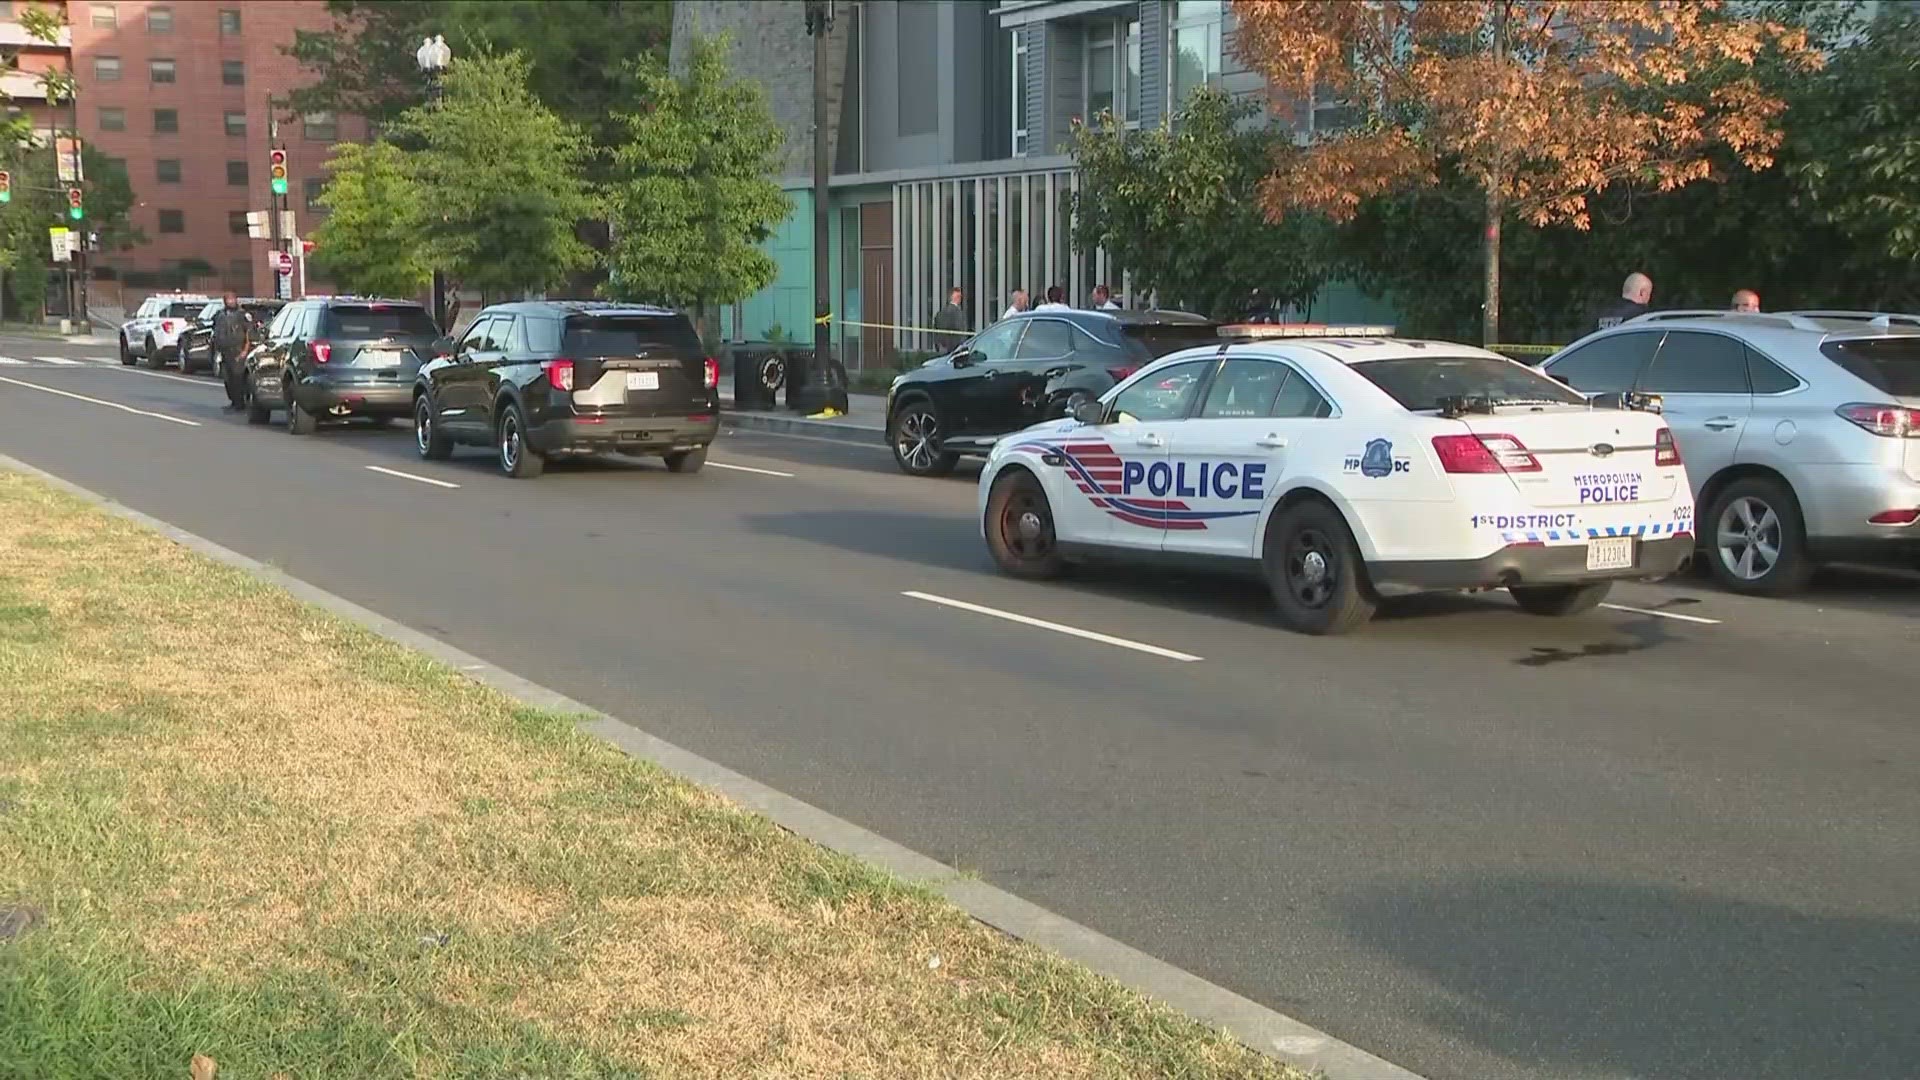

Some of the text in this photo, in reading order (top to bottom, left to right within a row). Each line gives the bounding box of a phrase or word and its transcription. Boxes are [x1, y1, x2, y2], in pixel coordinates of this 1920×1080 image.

[1343, 458, 1410, 472] MP DC
[1123, 461, 1267, 500] POLICE
[1573, 472, 1643, 487] METROPOLITAN
[1580, 485, 1639, 503] POLICE
[1496, 513, 1576, 529] DISTRICT
[1672, 506, 1692, 521] 1022
